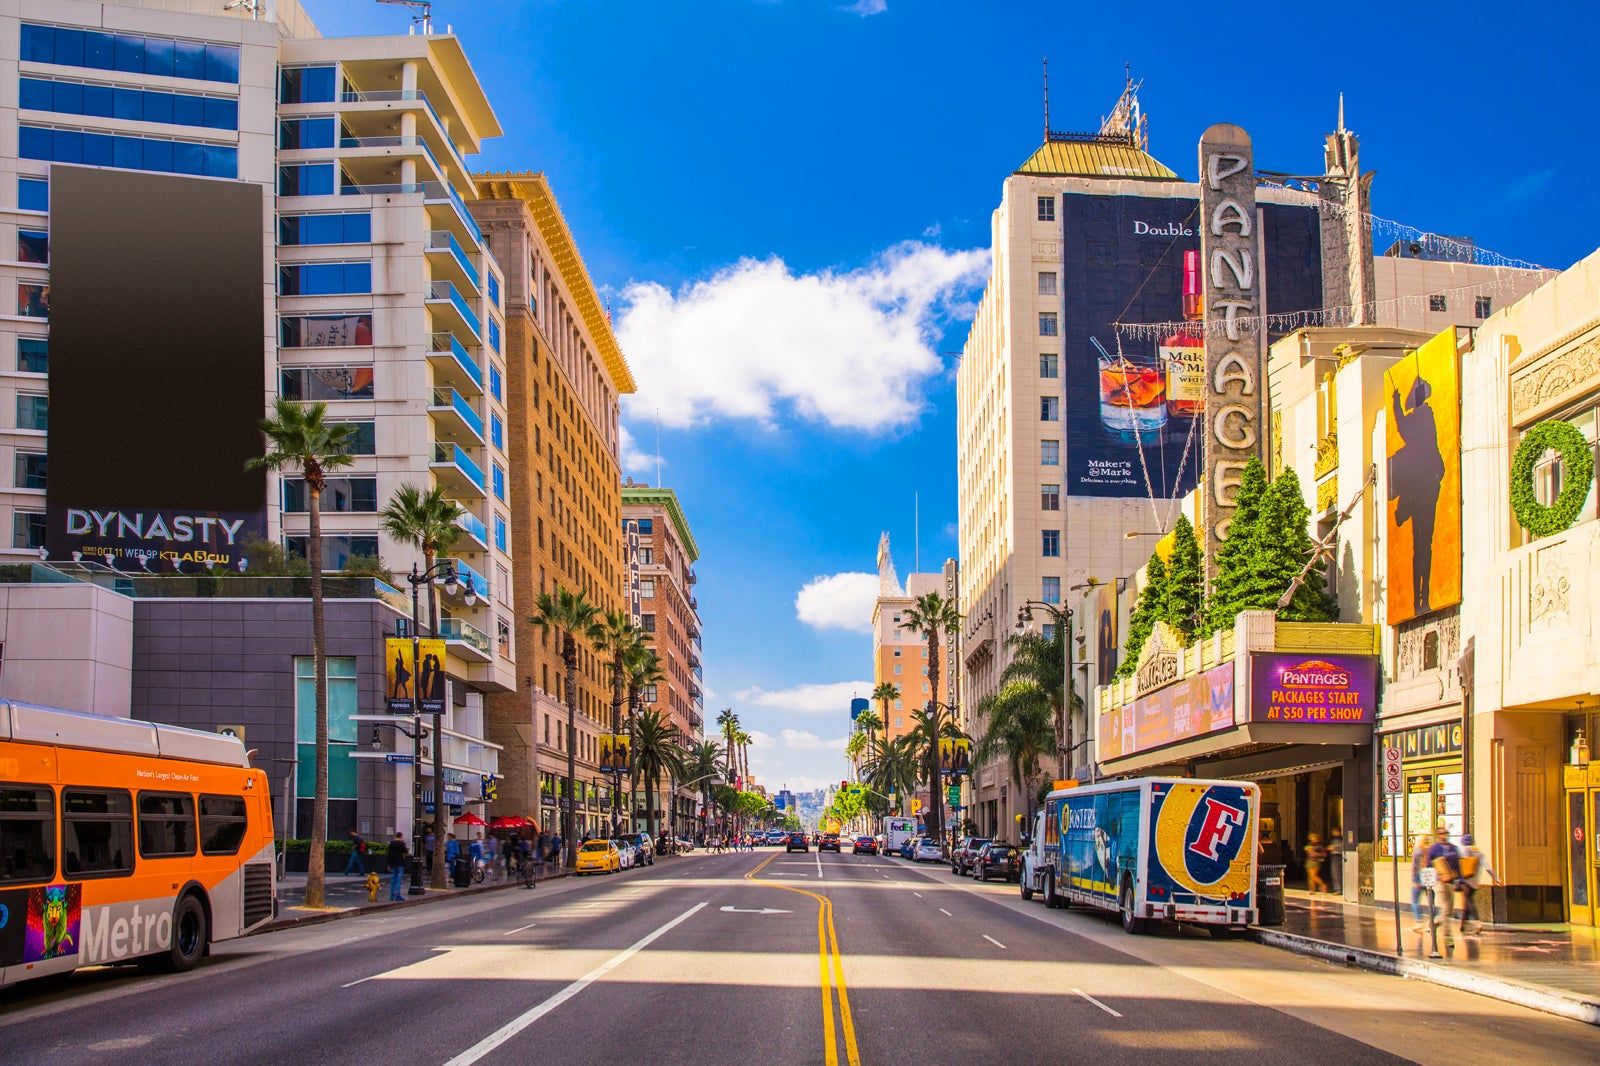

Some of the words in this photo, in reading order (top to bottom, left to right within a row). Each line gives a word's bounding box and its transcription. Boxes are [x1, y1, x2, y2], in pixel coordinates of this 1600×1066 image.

[1134, 220, 1193, 236] Double
[1169, 351, 1204, 362] Mak
[1088, 460, 1131, 468] Maker's
[1100, 468, 1131, 476] Mark
[66, 509, 245, 545] DYNASTY
[114, 547, 123, 557] 11
[124, 548, 145, 558] WED
[146, 550, 158, 560] 9P
[159, 551, 194, 562] KTLA
[629, 532, 640, 604] TAFT
[1282, 671, 1349, 686] PANTAGES
[1271, 690, 1325, 704] PACKAGES
[1327, 691, 1360, 705] START
[1267, 706, 1281, 719] AT
[1283, 706, 1304, 720] $50
[1307, 707, 1327, 719] PER
[1330, 708, 1364, 720] SHOW
[890, 822, 914, 832] FedEx
[78, 904, 172, 965] Metro
